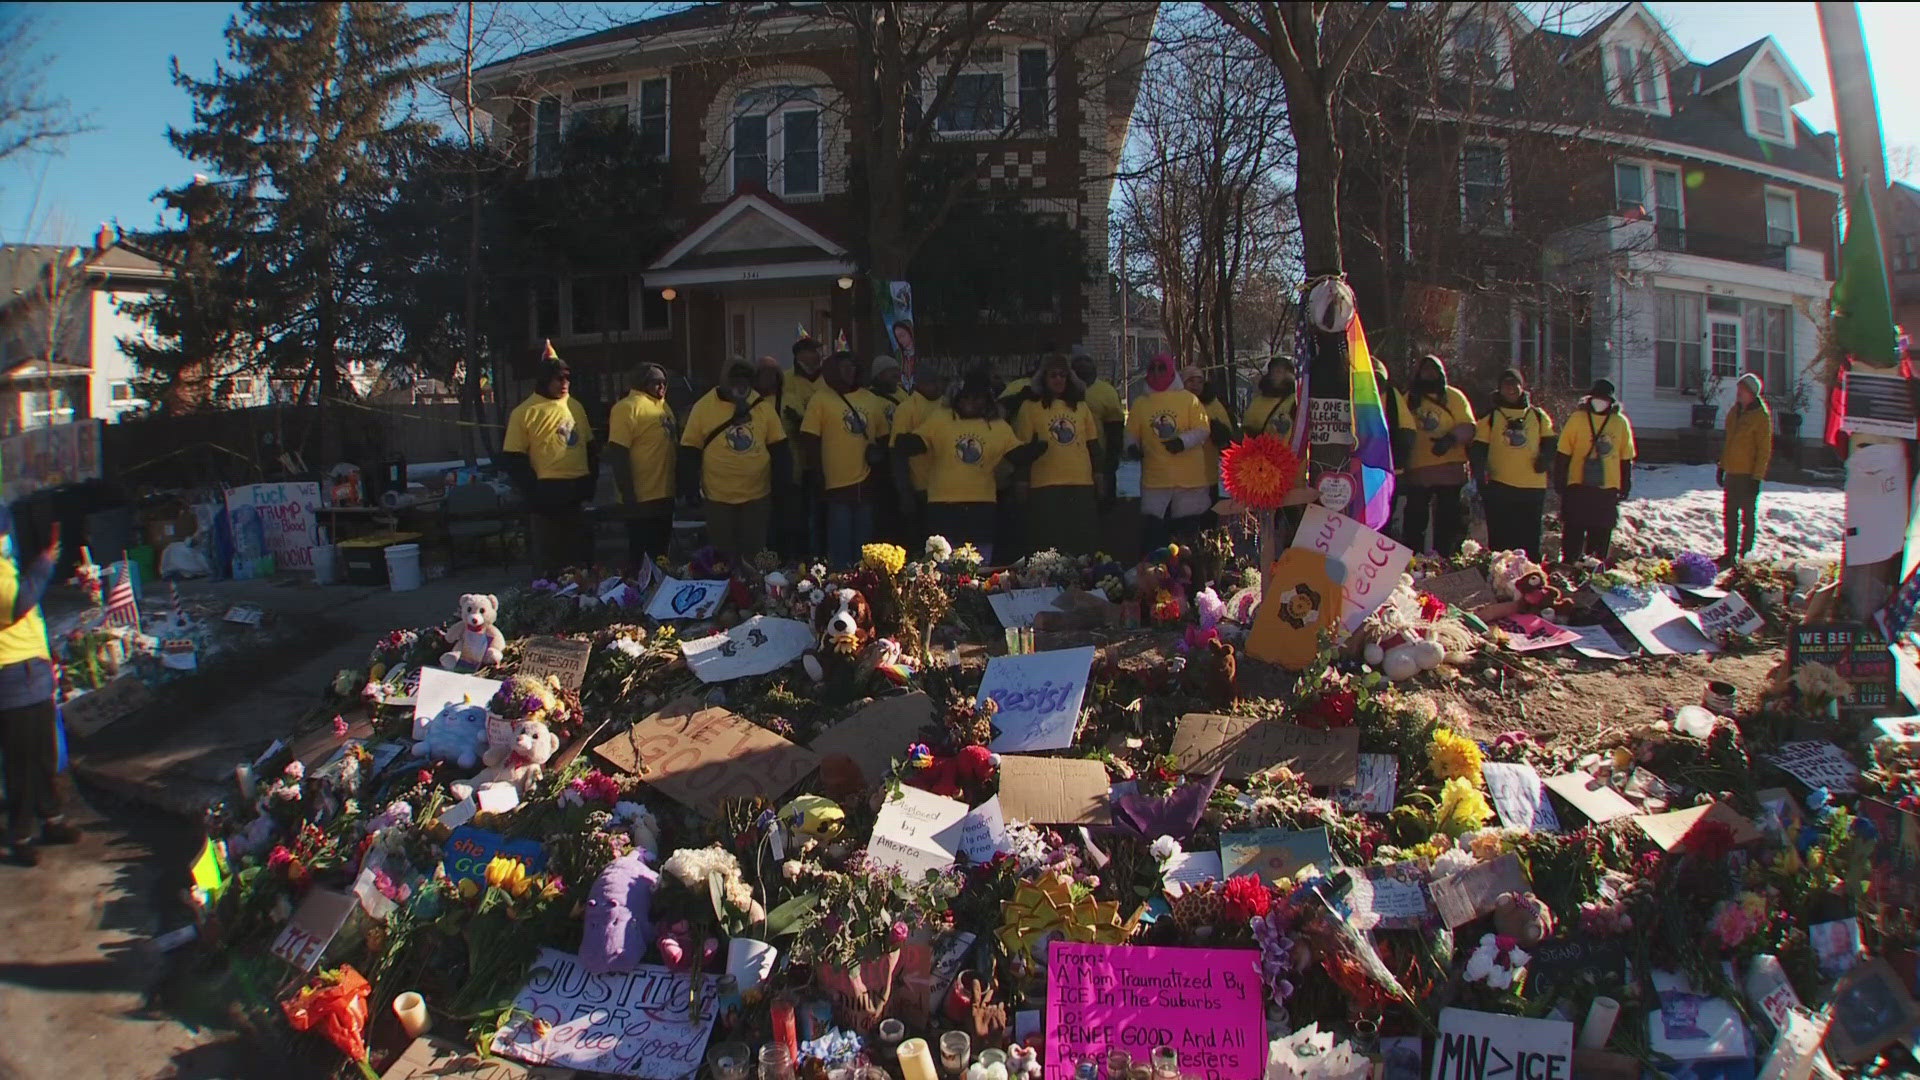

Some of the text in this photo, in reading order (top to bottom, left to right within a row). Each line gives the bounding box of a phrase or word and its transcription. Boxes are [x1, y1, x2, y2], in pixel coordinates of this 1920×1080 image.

[1310, 411, 1341, 421] LLEGAL
[1323, 401, 1342, 412] ONE
[1310, 432, 1330, 442] AND
[256, 501, 301, 520] TRUMP
[1800, 632, 1822, 644] WE
[524, 651, 580, 671] MINNESOTA
[1861, 694, 1887, 704] LIFE
[901, 820, 916, 836] by
[961, 815, 994, 833] reedom
[876, 835, 921, 858] America
[1056, 947, 1104, 967] From:
[529, 959, 718, 1022] JUSTICE
[1057, 966, 1247, 999] A Mom Traumatized By
[1057, 986, 1222, 1010] ICE In The Suburbs
[570, 1004, 632, 1029] FOR
[1054, 1003, 1083, 1025] To:
[1057, 1024, 1246, 1048] RENEE GOOD And All
[613, 1020, 709, 1073] Good
